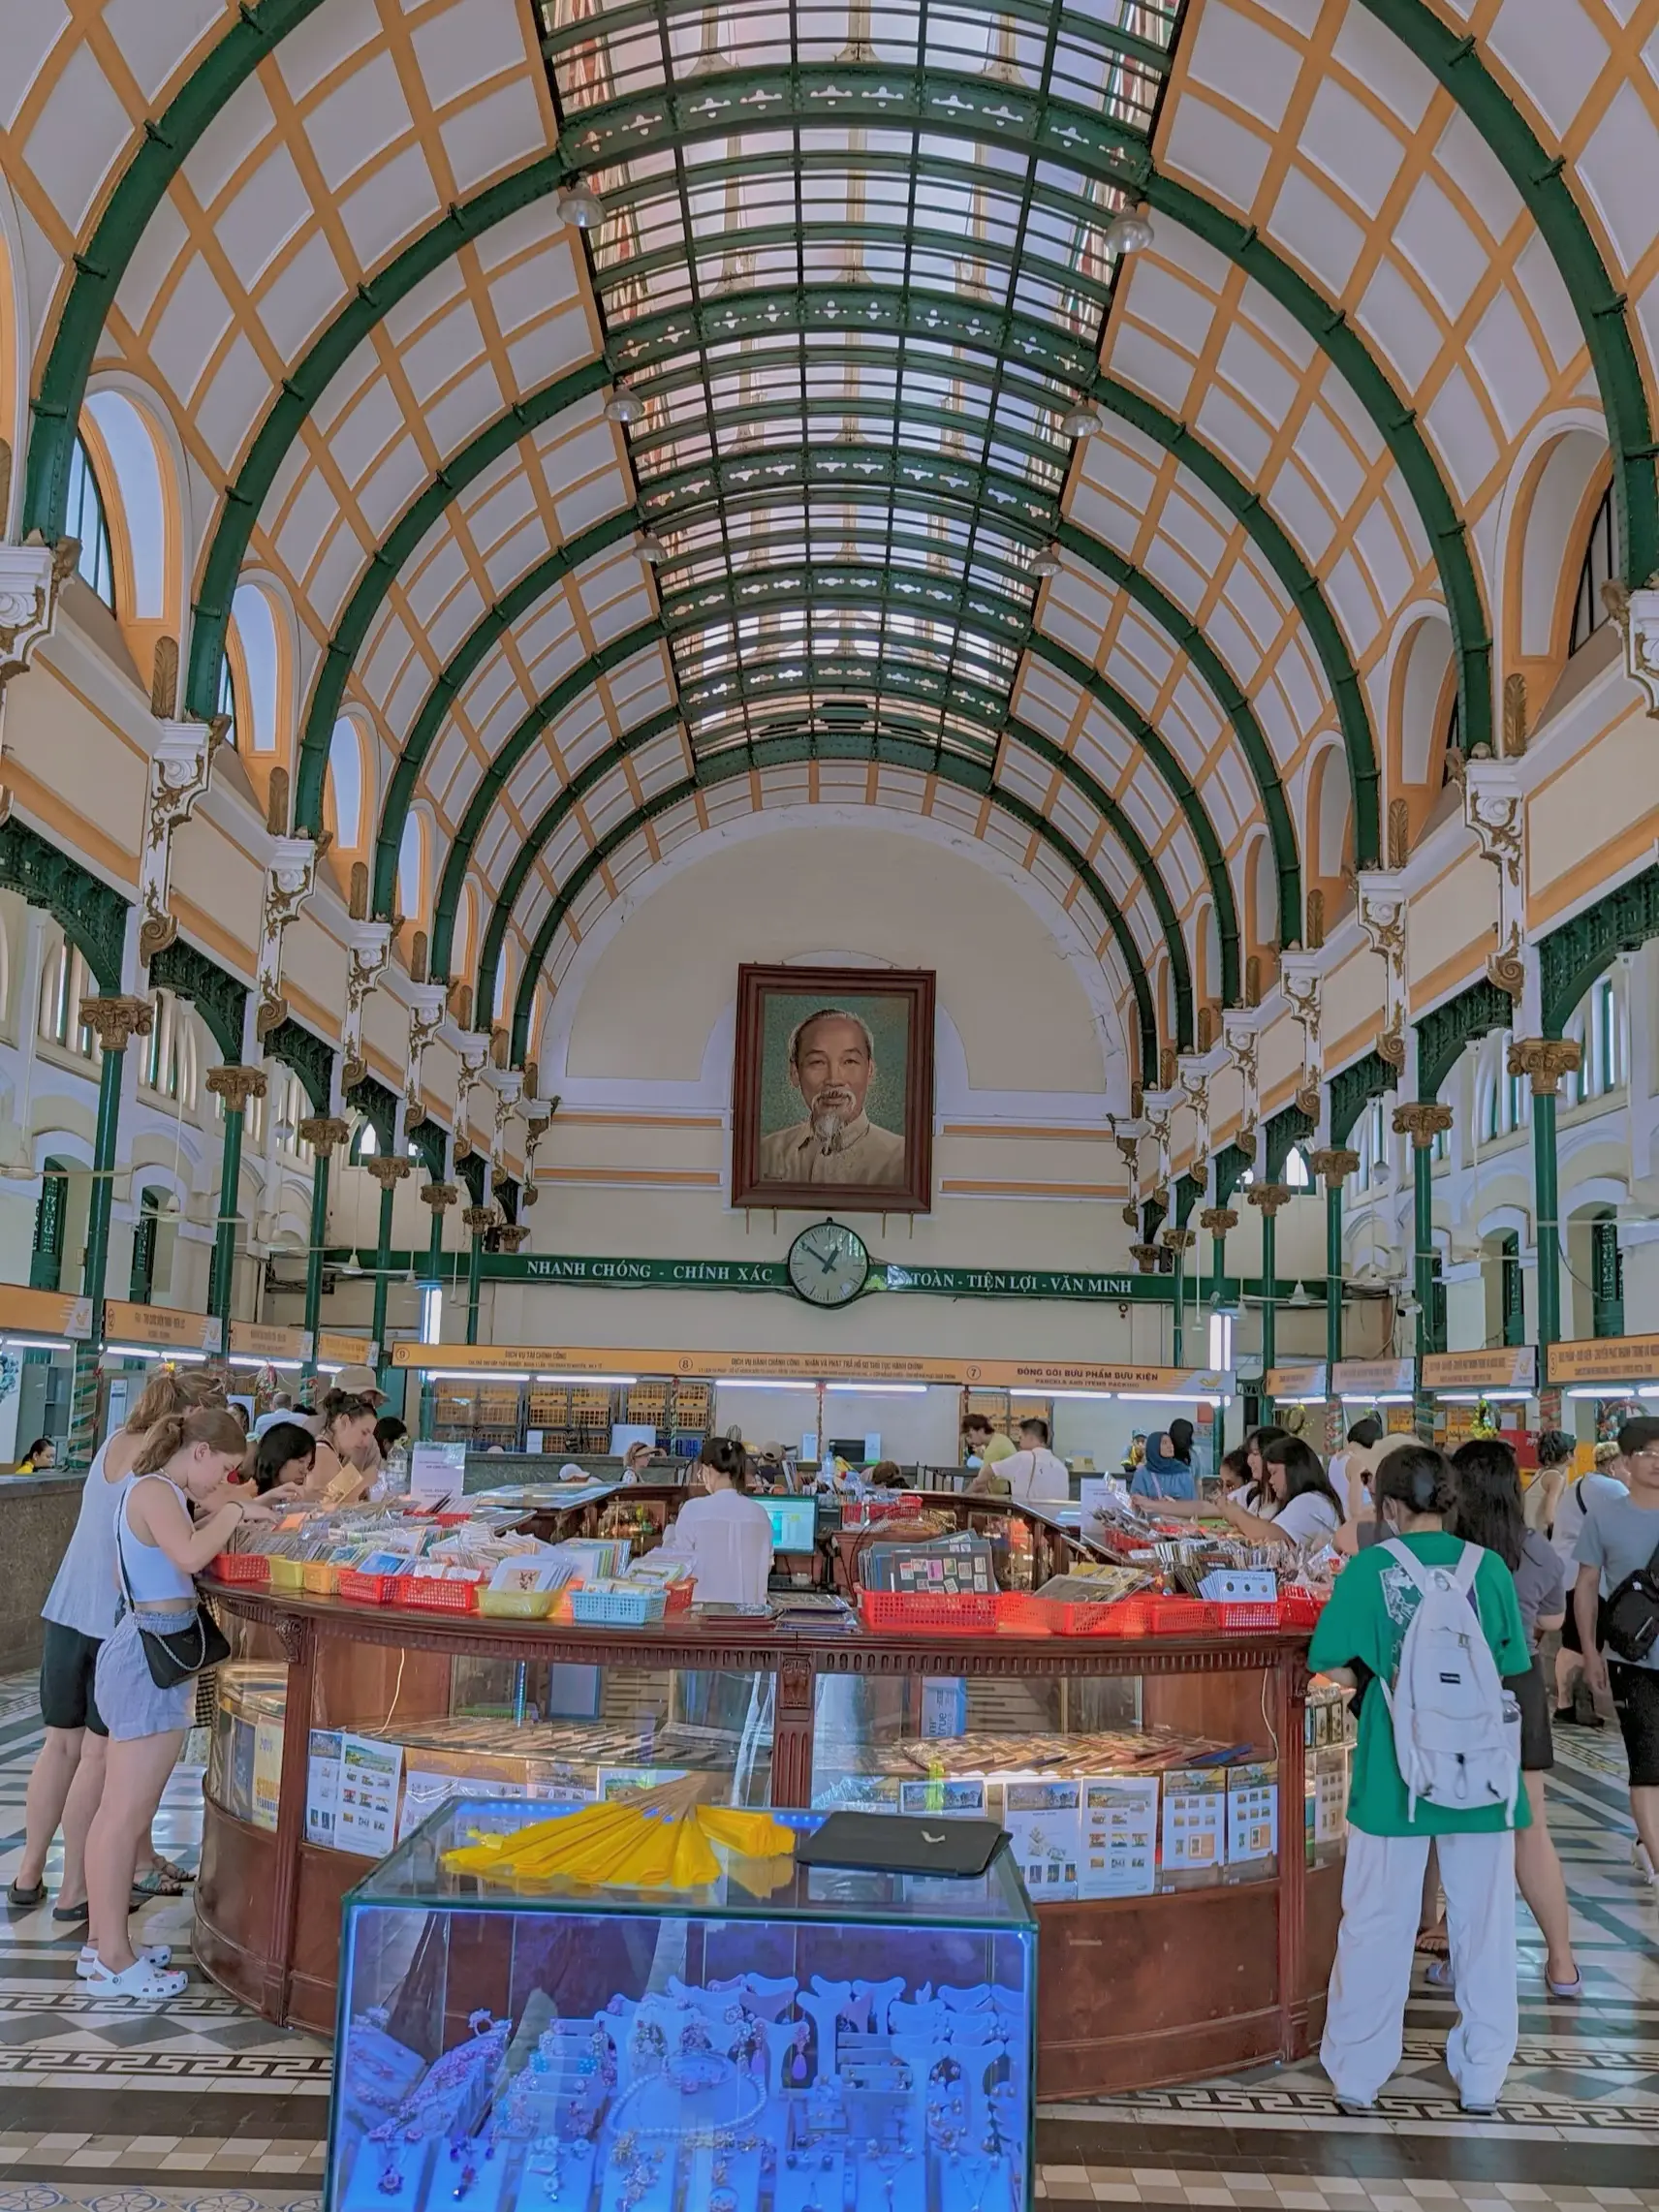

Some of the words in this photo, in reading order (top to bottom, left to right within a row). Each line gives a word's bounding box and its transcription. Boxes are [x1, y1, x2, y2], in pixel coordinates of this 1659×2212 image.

[527, 1261, 586, 1276] NHANH
[592, 1260, 652, 1278] CHÓNG
[673, 1262, 730, 1280] CHÍNH
[736, 1264, 773, 1282] XÁC
[911, 1269, 955, 1287] TOÀN
[967, 1271, 1005, 1291] TIỆN
[1010, 1274, 1038, 1293] LỢI
[1050, 1274, 1084, 1292] VĂN
[1087, 1277, 1133, 1293] MINH
[1017, 1366, 1043, 1376] ĐÓNG
[1046, 1367, 1062, 1377] GÓI
[1064, 1369, 1083, 1378] BƯU
[1085, 1367, 1112, 1379] PHẨM
[1114, 1371, 1134, 1380] BƯU
[1136, 1372, 1158, 1382] KIỆN
